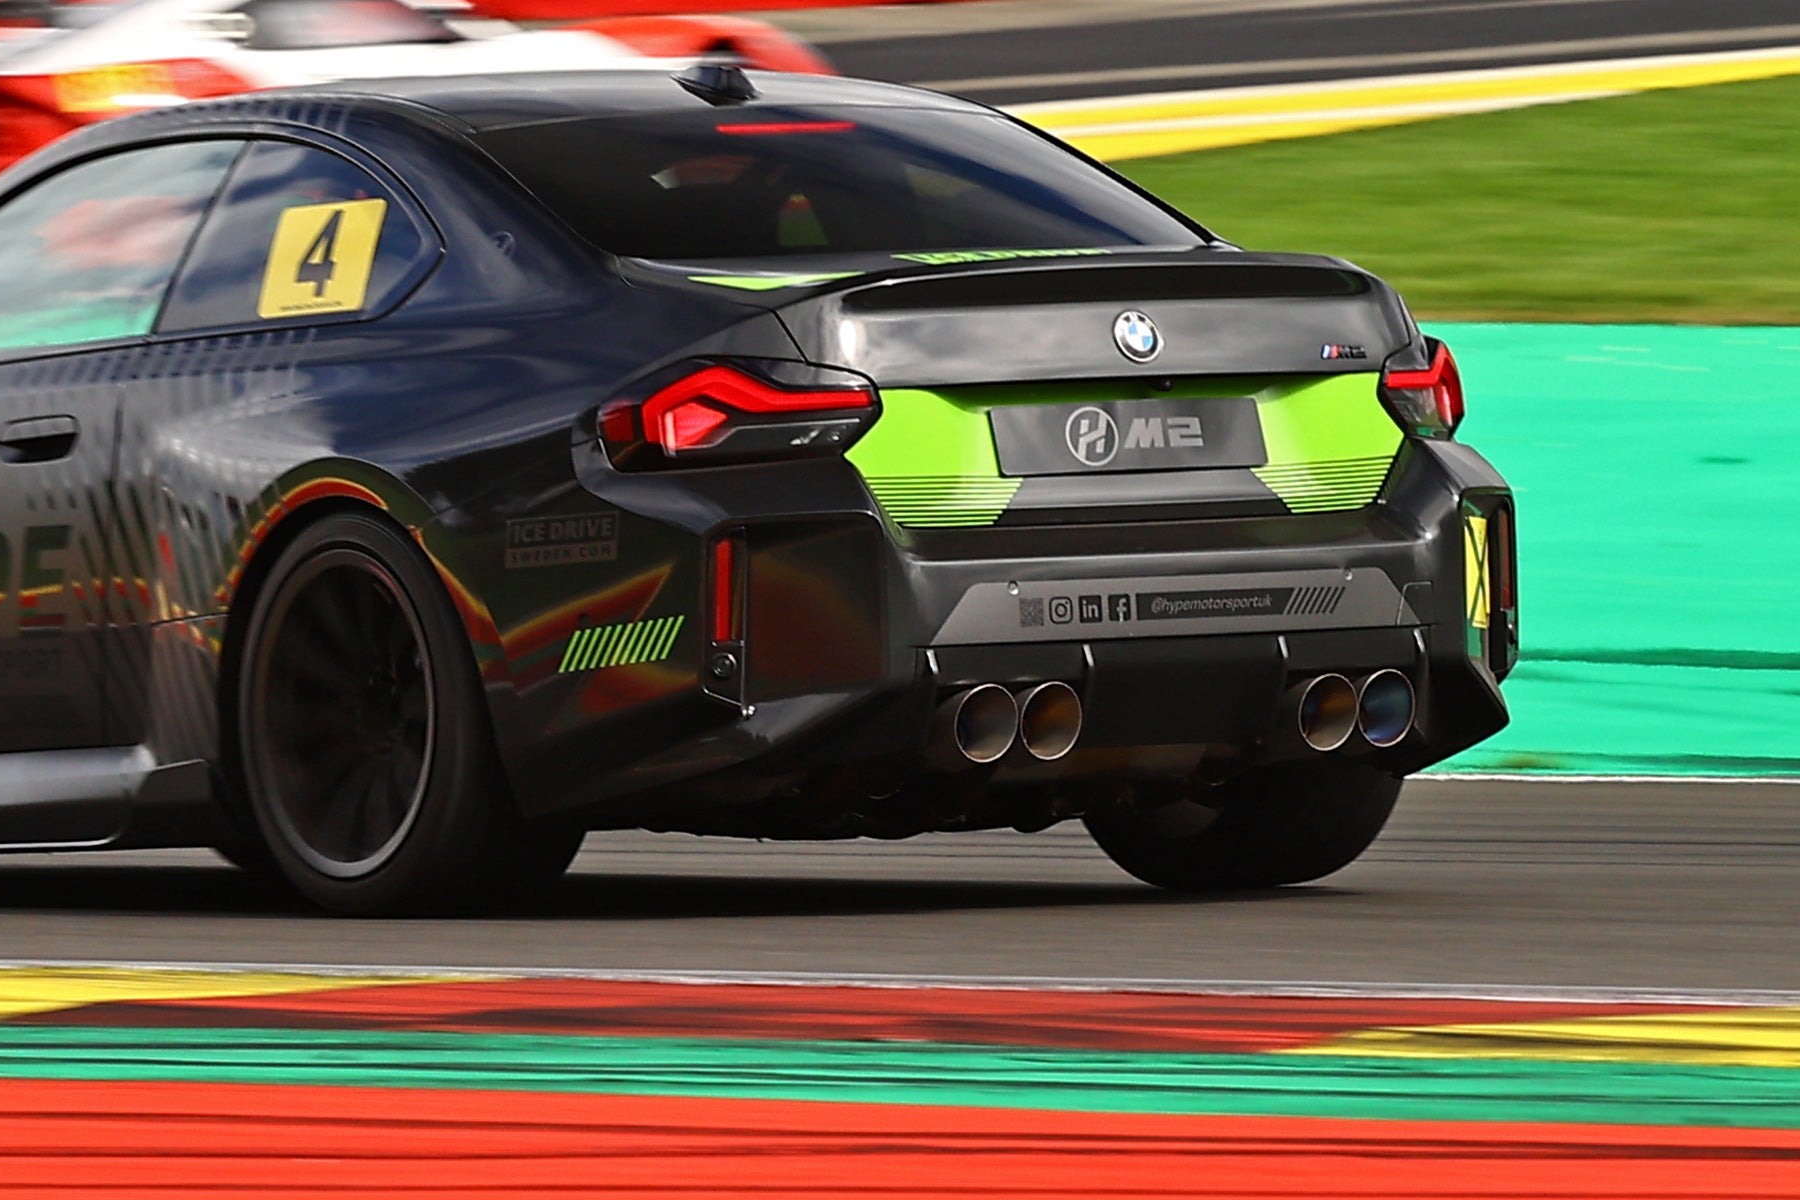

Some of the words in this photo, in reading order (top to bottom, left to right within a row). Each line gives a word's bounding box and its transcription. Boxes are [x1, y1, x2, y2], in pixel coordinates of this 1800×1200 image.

[295, 209, 346, 298] 4
[1124, 416, 1204, 449] M2
[513, 522, 545, 544] ICE
[551, 517, 613, 540] DRIVE
[1151, 593, 1273, 614] @hypemotorsportuk
